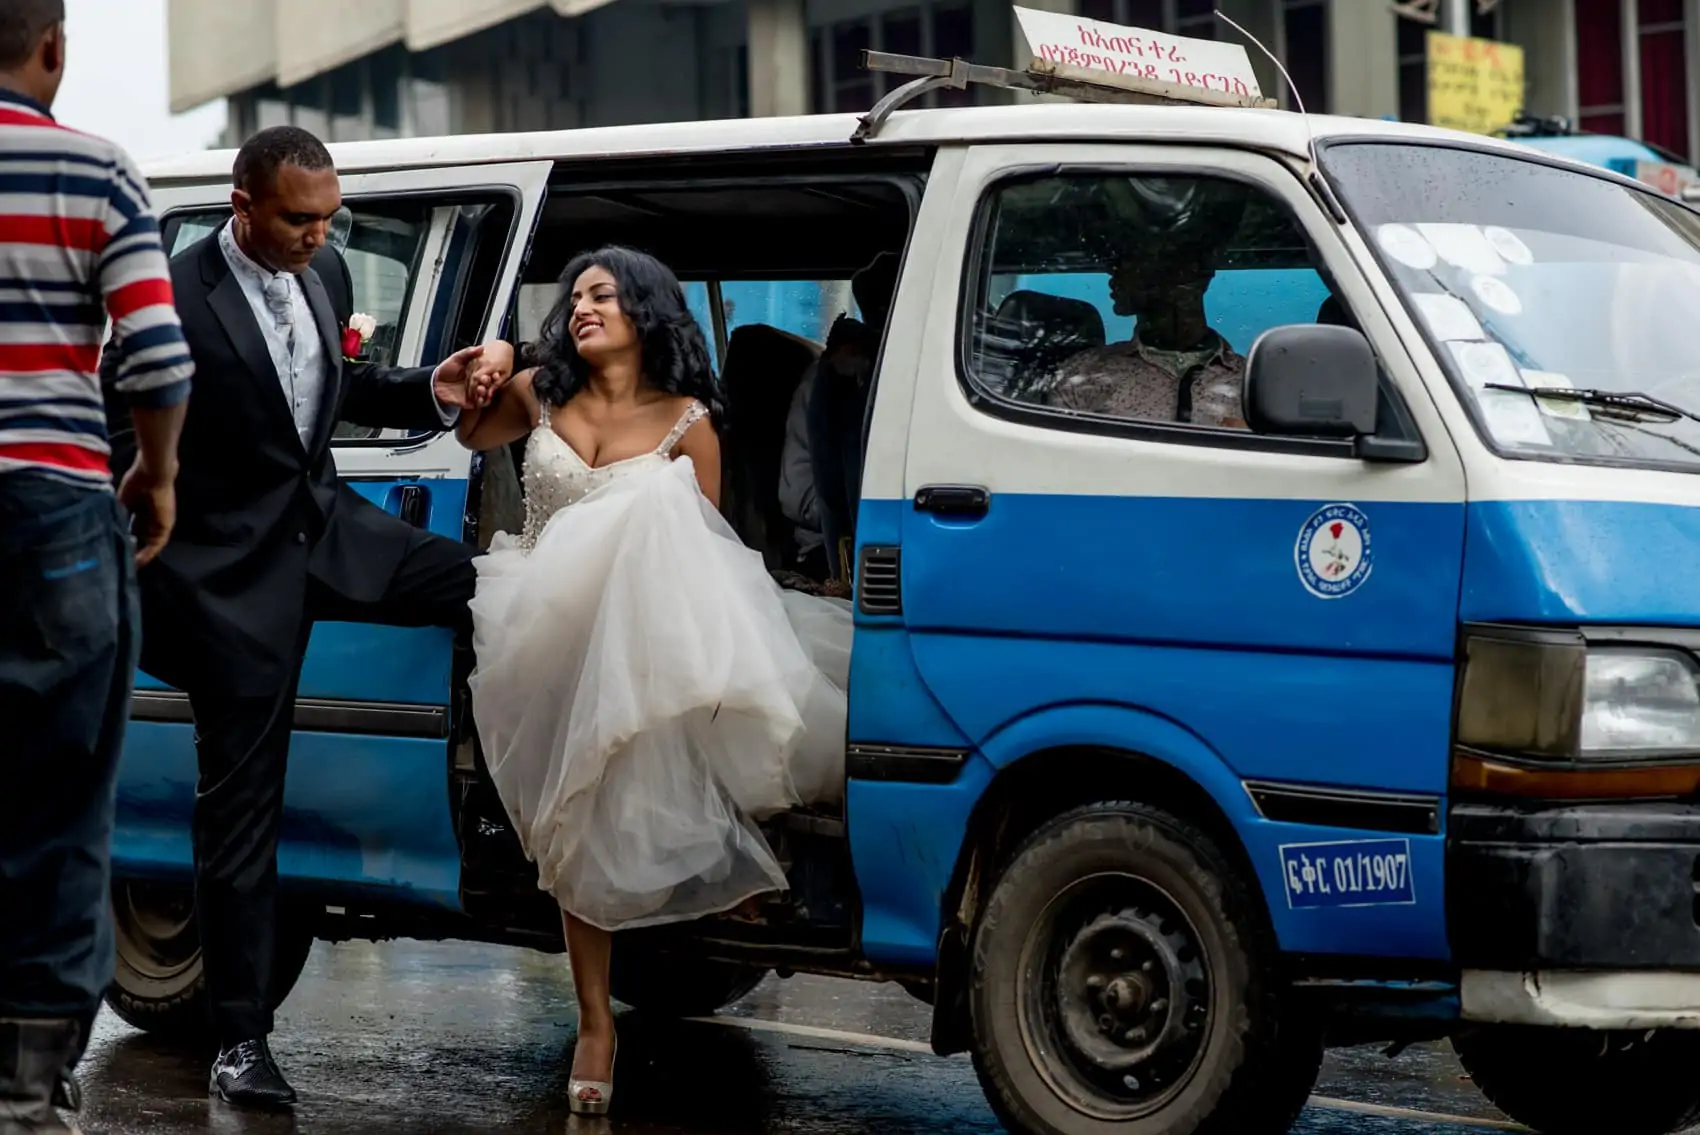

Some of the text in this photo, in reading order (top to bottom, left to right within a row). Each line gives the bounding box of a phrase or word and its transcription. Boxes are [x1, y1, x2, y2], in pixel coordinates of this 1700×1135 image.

[1148, 40, 1188, 63] ተራ
[1287, 852, 1407, 895] ፍቅር 01/1907
